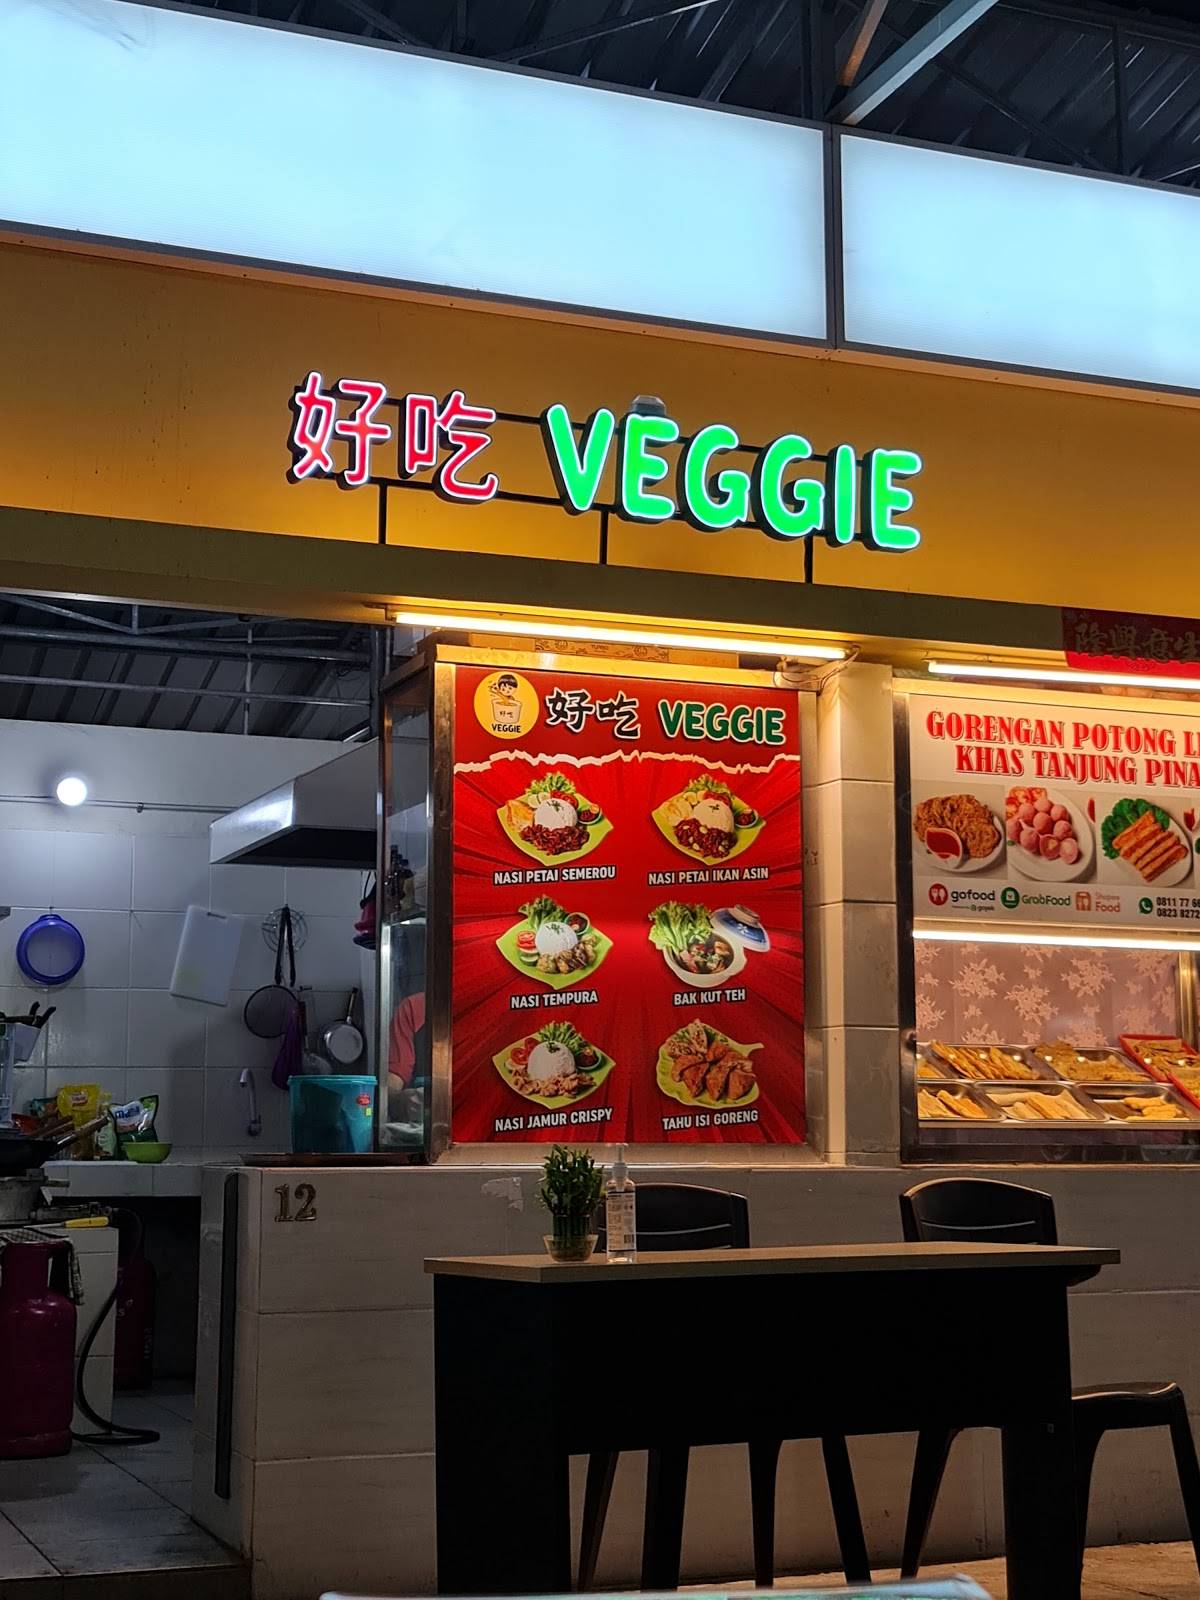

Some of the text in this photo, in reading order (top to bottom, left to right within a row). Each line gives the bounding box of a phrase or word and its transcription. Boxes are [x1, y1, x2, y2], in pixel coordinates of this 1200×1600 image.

[291, 371, 923, 551] 好吃 VEGGIE
[546, 688, 786, 745] 好吃 VEGGIE
[491, 723, 521, 733] VEGGIE
[926, 710, 1065, 748] GORENGAN
[1072, 722, 1176, 757] POTONG
[955, 745, 1024, 777] KHAS
[1032, 750, 1138, 785] TANJUNG
[494, 866, 616, 885] NASI PETAI SEMEROU
[648, 867, 769, 885] NASI PETAI IKAN ASIN
[951, 889, 995, 902] gofood
[1021, 894, 1071, 906] GrabFood
[1156, 897, 1176, 907] 0811
[1179, 898, 1189, 907] 77
[1095, 901, 1120, 912] Food
[511, 991, 598, 1009] NASI TEMPURA
[674, 989, 746, 1006] BAK KUT TEH
[495, 1108, 613, 1132] NASI JAMUR CRISPY
[662, 1110, 758, 1130] TAHU ISI GORENG
[274, 1183, 317, 1222] 12
